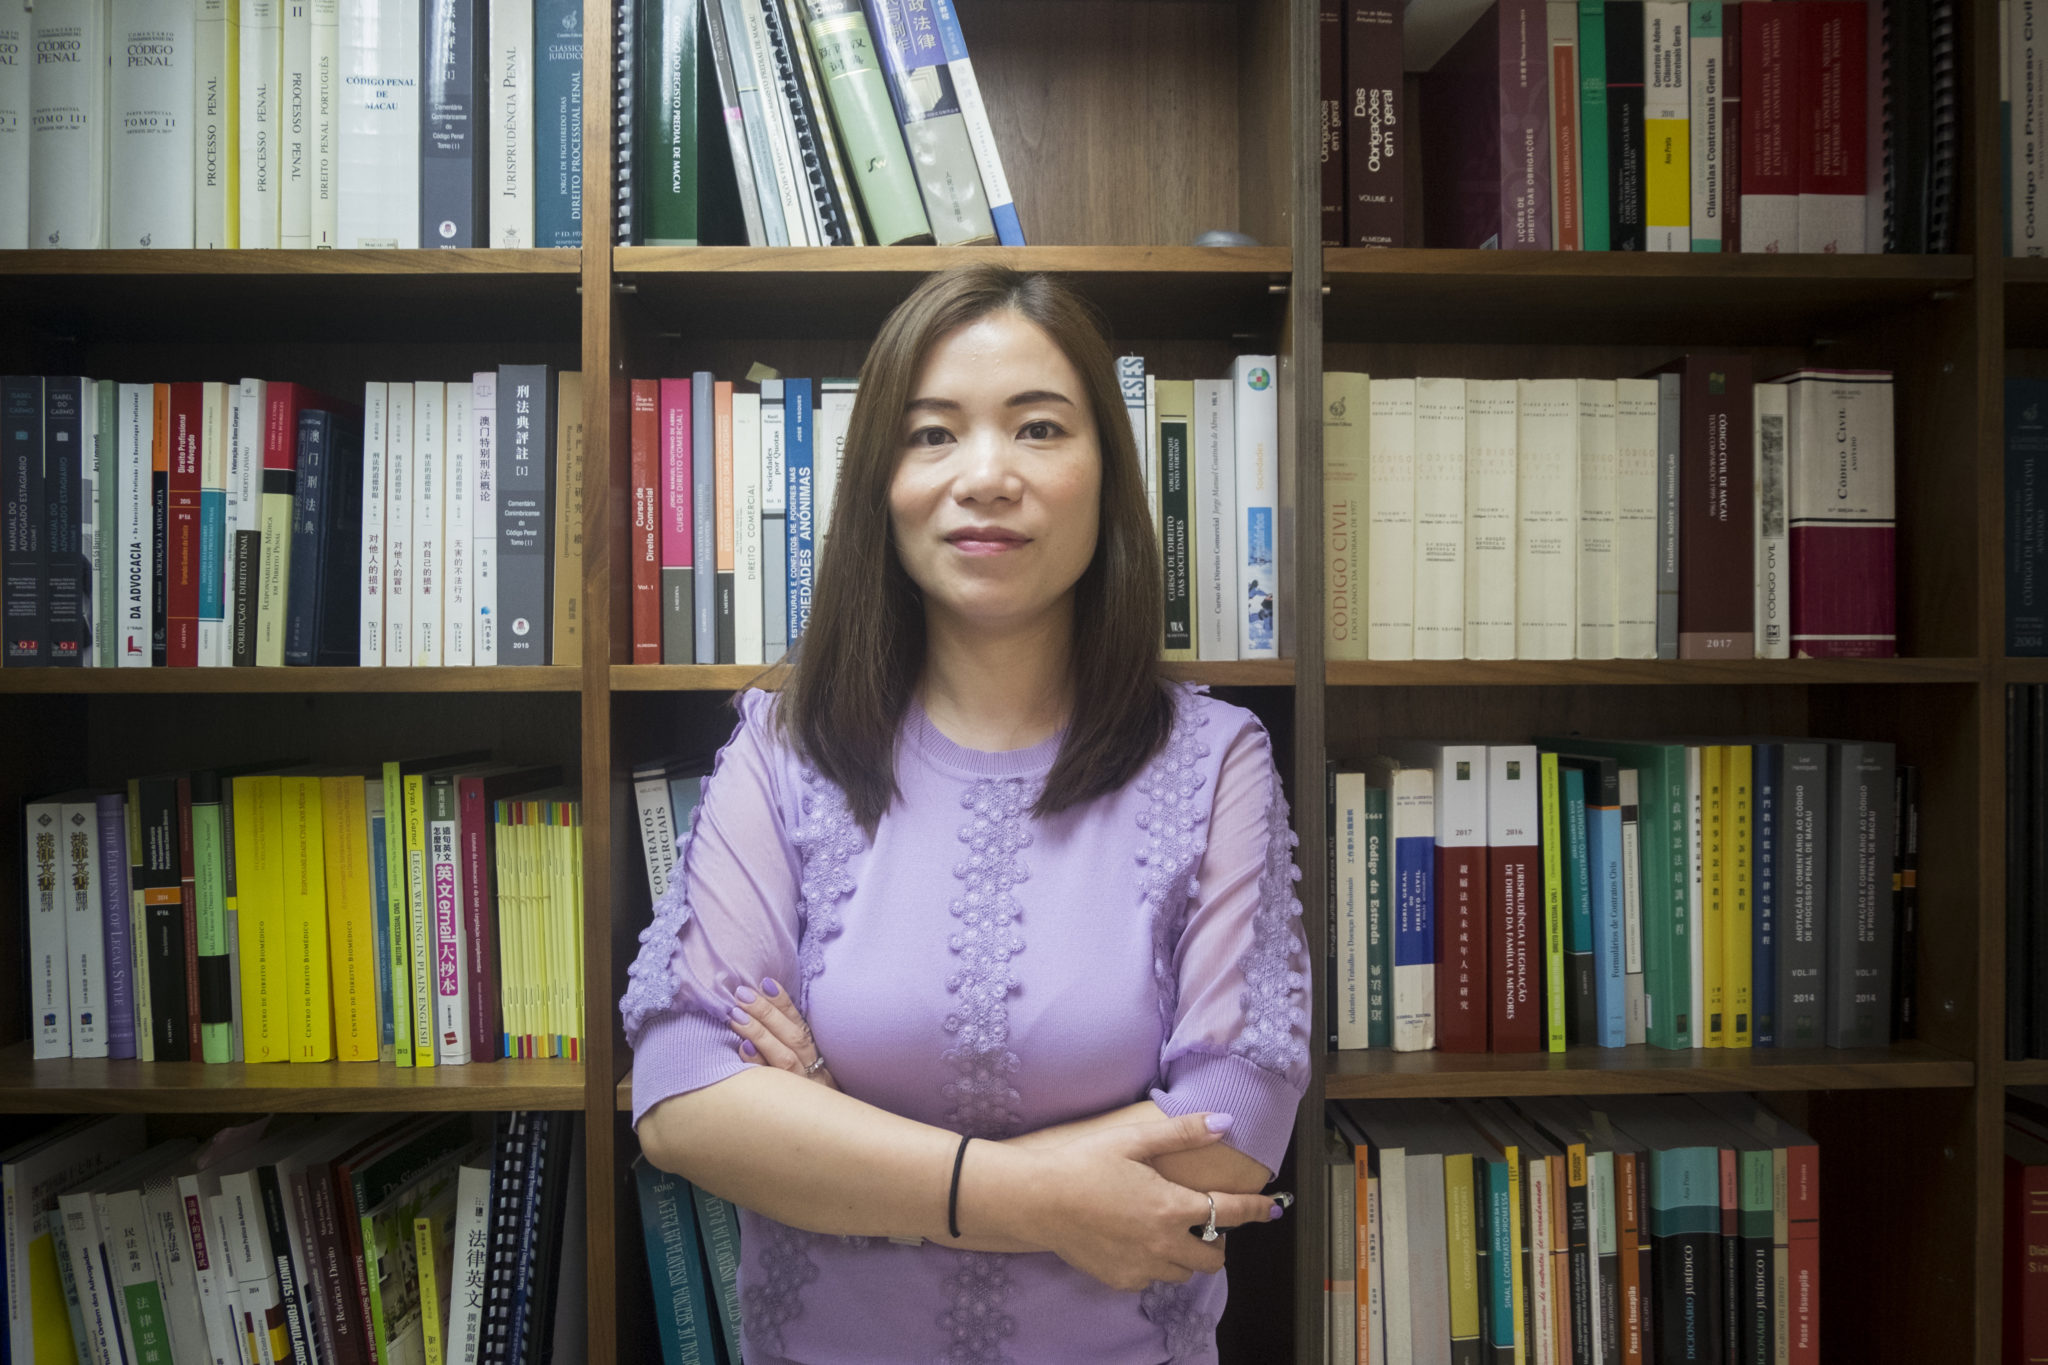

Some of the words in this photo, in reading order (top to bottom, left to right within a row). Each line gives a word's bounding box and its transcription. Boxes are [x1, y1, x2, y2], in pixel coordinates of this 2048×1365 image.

[1653, 18, 1662, 42] Adesão
[1673, 25, 1682, 47] Gerais
[2024, 0, 2034, 42] Civil
[37, 40, 81, 53] CÓDIGO
[37, 52, 81, 65] PENAL
[127, 43, 173, 56] CÓDIGO
[127, 56, 173, 67] PENAL
[673, 54, 681, 69] DO
[1653, 43, 1662, 52] de
[346, 76, 385, 87] CÓDIGO
[386, 78, 416, 87] PENAL
[1653, 53, 1662, 87] Contratos
[1673, 48, 1682, 88] Contratuais
[1706, 58, 1716, 94] Gerais
[207, 76, 217, 116] PENAL
[320, 55, 329, 115] PORTUGUÊS
[376, 90, 389, 99] DE
[571, 71, 581, 104] PENAL
[673, 72, 681, 108] REGISTO
[2024, 47, 2034, 136] Processo
[257, 83, 267, 123] PENAL
[292, 72, 302, 134] PROCESSO
[365, 101, 398, 111] MACAU
[560, 96, 568, 113] DIAS
[1354, 88, 1366, 117] Das
[1382, 89, 1396, 126] geral
[32, 115, 63, 125] TOMO
[70, 114, 87, 123] III
[123, 118, 158, 127] TOMO
[165, 119, 176, 127] II
[673, 110, 681, 146] PREDIAL
[1368, 88, 1382, 173] Obrigações
[1706, 96, 1716, 161] Contratuais
[320, 120, 329, 154] PENAL
[560, 115, 568, 159] FIGUEIREDO
[571, 107, 581, 173] PROCESSUAL
[673, 148, 681, 159] DE
[1384, 131, 1394, 158] em
[2025, 142, 2034, 165] de
[207, 125, 217, 187] PROCESSO
[257, 131, 267, 192] PROCESSO
[292, 142, 302, 182] PENAL
[560, 161, 568, 170] DE
[1526, 128, 1536, 186] OBRIGAÇÕES
[320, 158, 329, 200] DIREITO
[560, 172, 568, 195] JORGE
[673, 161, 681, 194] MACAU
[1706, 163, 1716, 218] Cláusulas
[571, 176, 581, 220] DIREITO
[1359, 195, 1387, 203] VOLUME
[1518, 196, 1525, 209] DE
[1527, 188, 1535, 205] DAS
[2025, 170, 2036, 239] Código
[1527, 208, 1536, 243] DIREITO
[52, 393, 73, 401] ISABEL
[178, 414, 186, 451] Profissional
[676, 413, 684, 458] COMERCIAL
[1719, 413, 1728, 450] CÓDIGO
[1836, 407, 1847, 443] CIVIL
[178, 452, 186, 473] Direito
[188, 465, 195, 473] do
[479, 416, 491, 502] 澳门特别刑法概论
[1719, 452, 1728, 473] CIVIL
[1837, 451, 1848, 500] CÓDIGO
[19, 455, 28, 498] ESTAGIÁRIO
[676, 461, 684, 491] DIREITO
[1667, 454, 1676, 498] simulação
[1719, 476, 1728, 487] DE
[8, 501, 17, 515] DO
[636, 488, 644, 499] de
[646, 488, 654, 531] Comercial
[676, 493, 684, 503] DE
[789, 485, 797, 520] PODERES
[798, 467, 811, 540] ANÓNIMAS
[1719, 490, 1728, 521] MACAU
[19, 500, 28, 552] ADVOGADO
[636, 500, 644, 527] Curso
[676, 505, 684, 533] CURSO
[748, 484, 756, 538] COMERCIAL
[1333, 500, 1347, 552] CIVIL
[8, 518, 17, 552] MANUAL
[790, 523, 797, 534] DE
[1167, 516, 1175, 553] DIREITO
[240, 535, 248, 559] PENAL
[646, 533, 654, 561] Direito
[748, 545, 756, 581] DIREITO
[790, 536, 798, 578] CONFLITOS
[1167, 555, 1175, 567] DE
[1177, 520, 1185, 576] SOCIEDADES
[1768, 543, 1777, 569] CIVIL
[130, 542, 142, 598] ADVOCACIA
[239, 562, 247, 595] DIREITO
[368, 534, 379, 595] 对他人的损害
[423, 541, 432, 595] 对自己的损害
[1167, 570, 1175, 601] CURSO
[1177, 579, 1185, 597] DAS
[1333, 557, 1347, 641] CÓDIGO
[1768, 572, 1777, 619] CÓDIGO
[130, 602, 141, 619] DA
[238, 603, 247, 655] CORRUPÇÃO
[1706, 639, 1732, 648] 2017
[2013, 636, 2043, 648] 2004
[409, 782, 417, 806] Bryan
[1795, 784, 1803, 817] CÓDIGO
[411, 808, 417, 816] A.
[1796, 820, 1803, 831] AO
[1805, 810, 1813, 840] MACAU
[104, 825, 116, 846] THE
[443, 826, 452, 862] 這句英文
[1455, 828, 1473, 837] 2017
[1506, 828, 1523, 837] 2016
[1805, 842, 1813, 853] DE
[643, 808, 664, 895] CONTRATOS
[1368, 835, 1380, 876] Código
[1795, 833, 1803, 887] COMENTÁRIO
[106, 850, 119, 909] ELEMENTS
[412, 853, 420, 888] LEGAL
[1505, 864, 1513, 875] DE
[1805, 855, 1813, 882] PENAL
[1370, 879, 1380, 894] da
[1505, 878, 1513, 914] DIREITO
[1516, 864, 1526, 939] JURISPRUDÊNCIA
[1610, 882, 1618, 918] Contratos
[110, 912, 120, 927] OF
[414, 891, 423, 941] WRITING
[1370, 898, 1381, 945] Estrada
[1795, 897, 1804, 942] ANOTAÇÃO
[1805, 884, 1813, 928] PROCESSO
[1506, 917, 1513, 929] DA
[1611, 919, 1618, 929] de
[1805, 931, 1813, 941] DE
[111, 931, 124, 967] LEGAL
[417, 946, 423, 955] IN
[1506, 932, 1514, 968] FAMÍLIA
[1611, 931, 1620, 978] Formulários
[112, 970, 125, 1007] STYLE
[417, 961, 426, 994] PLAIN
[1517, 950, 1527, 1003] LEGISLAÇÃO
[304, 998, 311, 1006] DE
[1507, 977, 1515, 1019] MENORES
[1794, 993, 1815, 1003] 2014
[1856, 993, 1877, 1003] 2014
[419, 997, 428, 1045] ENGLISH
[303, 1045, 314, 1057] 11
[1460, 1184, 1469, 1225] CREDORES
[664, 1228, 681, 1243] DA
[1462, 1227, 1469, 1237] DE
[1501, 1192, 1511, 1277] CONTRATO-PROMESSA
[83, 1247, 96, 1291] Advogados
[328, 1246, 339, 1278] Direito
[464, 1229, 488, 1309] 法律英文
[1463, 1239, 1471, 1282] CONCURSO
[1757, 1249, 1765, 1257] II
[356, 1255, 367, 1285] Manual
[1465, 1282, 1471, 1290] O
[1684, 1245, 1696, 1295] JURÍDICO
[1757, 1259, 1767, 1309] JURÍDICO
[91, 1293, 99, 1307] dos
[333, 1285, 345, 1321] Retórica
[361, 1286, 369, 1295] de
[1504, 1285, 1512, 1308] SINAL
[1629, 1286, 1638, 1322] Usucapião
[1799, 1269, 1809, 1313] Usucapião
[94, 1309, 104, 1336] Ordem
[276, 1255, 294, 1297] MINUTAS
[286, 1304, 307, 1365] FORMULÁRIOS
[362, 1297, 376, 1350] Sobrevivência
[98, 1338, 106, 1347] da
[338, 1324, 347, 1335] de
[1629, 1334, 1638, 1354] Posse
[1686, 1297, 1696, 1359] DICIONÁRIO
[1757, 1311, 1765, 1365] ICIONÁRIO
[1799, 1323, 1808, 1349] Posse
[371, 1352, 378, 1362] do
